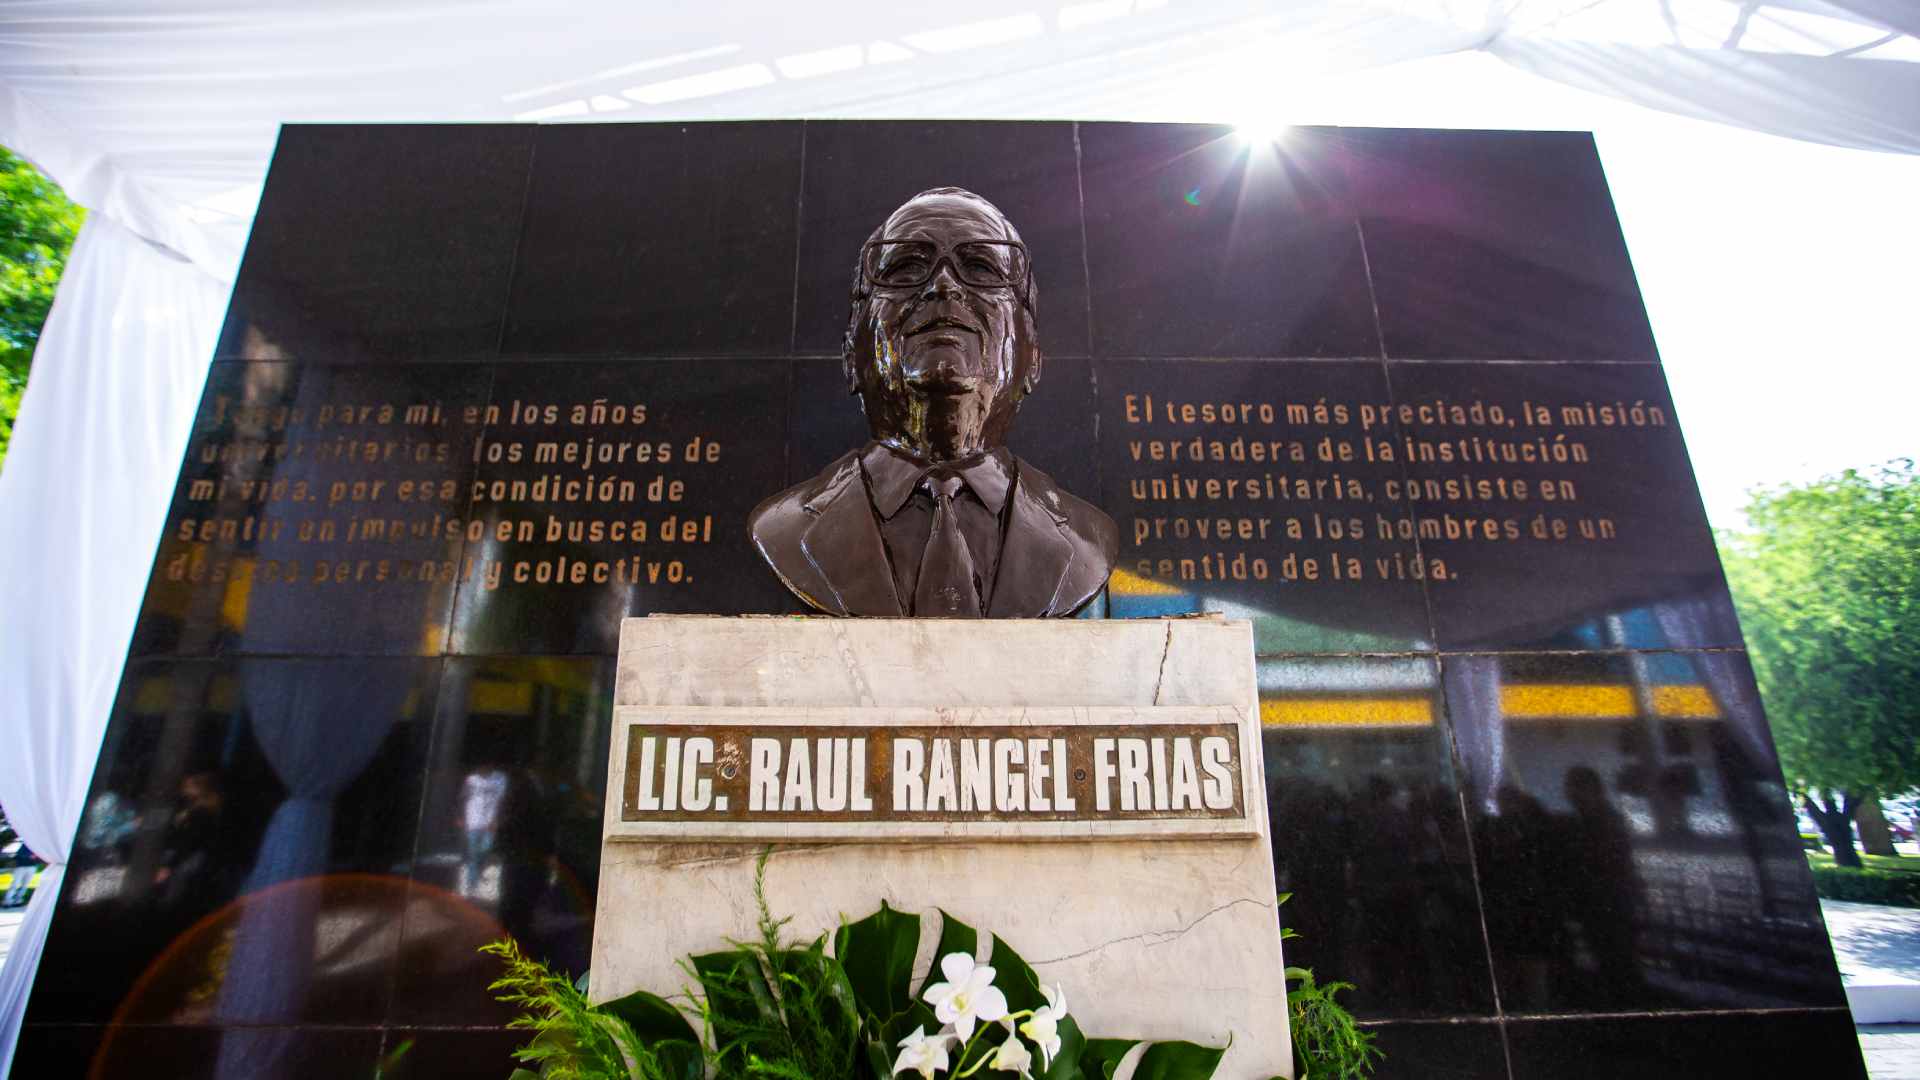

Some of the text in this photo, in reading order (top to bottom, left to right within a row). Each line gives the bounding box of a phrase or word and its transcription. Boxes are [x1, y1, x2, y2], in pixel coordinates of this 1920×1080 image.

[318, 402, 395, 429] para
[464, 404, 499, 425] en
[512, 399, 559, 425] los
[570, 398, 647, 425] años
[1125, 394, 1665, 430] El tesoro más preciado, la misión
[473, 437, 522, 462] los
[534, 437, 672, 470] mejores
[684, 437, 721, 463] de
[1130, 434, 1588, 463] verdadera de la institución
[329, 478, 385, 508] por
[398, 478, 456, 500] esa
[472, 475, 635, 501] condición
[647, 475, 685, 501] de
[1131, 473, 1576, 502] universitaria, consiste en
[178, 515, 284, 542] sentir
[347, 513, 484, 546] impulso
[495, 519, 534, 542] en
[546, 515, 647, 542] busca
[660, 515, 713, 543] del
[1134, 513, 1616, 546] proveer a los hombres de un
[480, 559, 502, 590] y
[514, 556, 693, 583] colectivo.
[1136, 552, 1457, 581] sentido de la vida.
[638, 736, 1236, 813] LIC. RAUL RANGEL FRIAS
